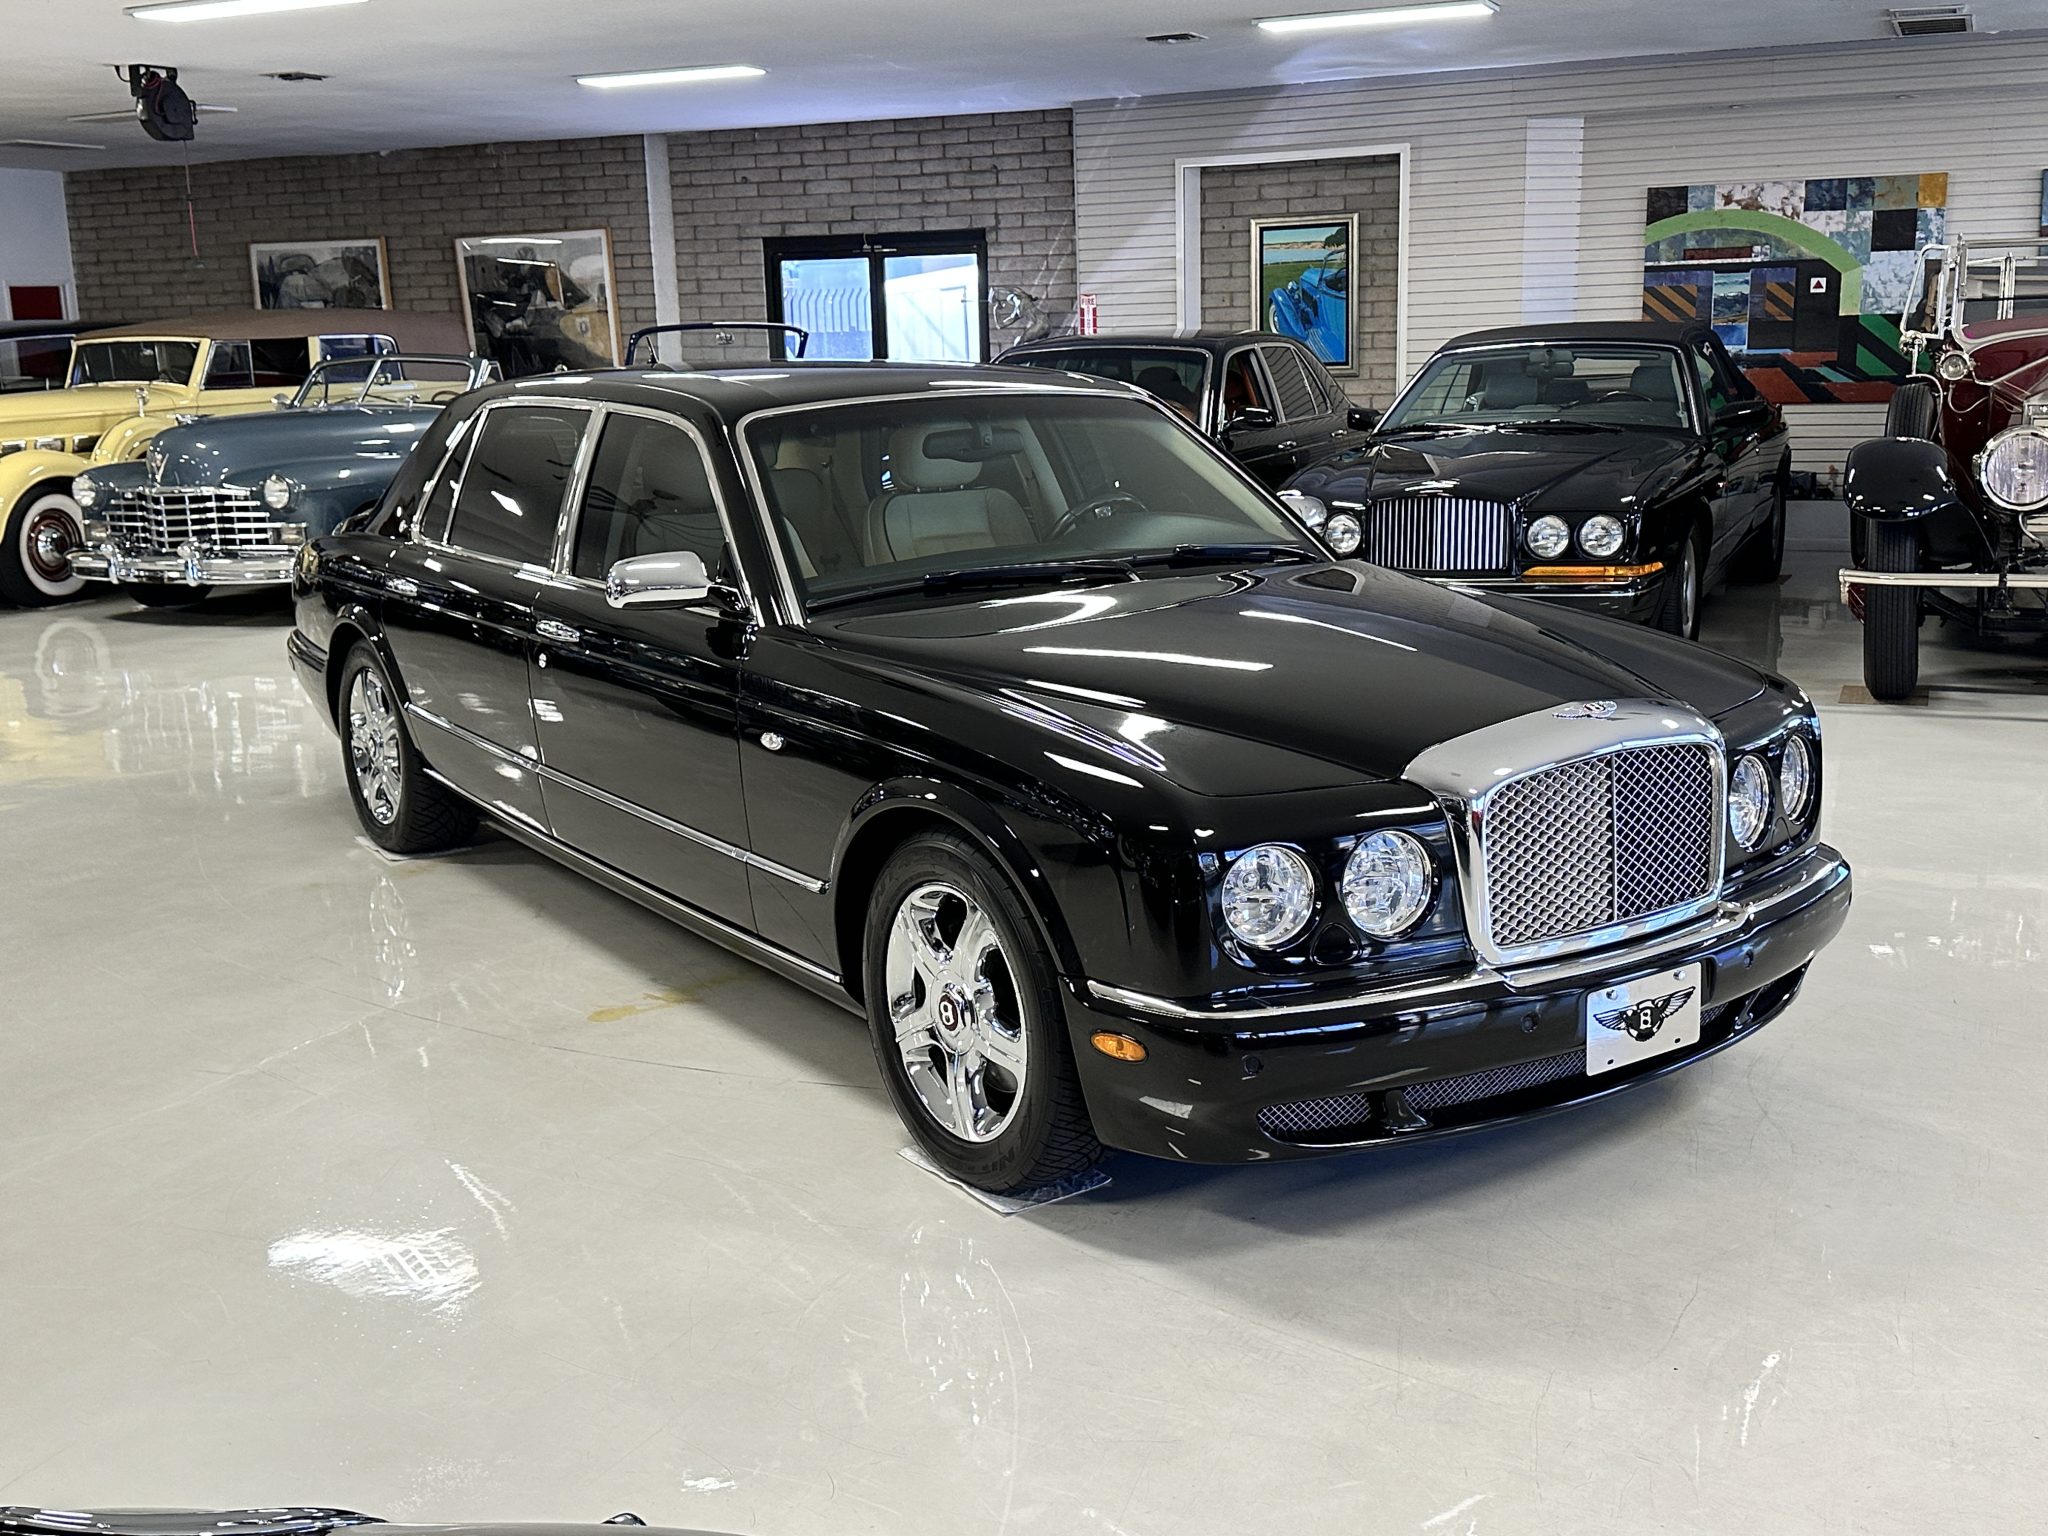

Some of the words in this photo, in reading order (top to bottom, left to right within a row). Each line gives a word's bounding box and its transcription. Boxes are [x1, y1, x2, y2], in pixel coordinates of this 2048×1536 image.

[1081, 297, 1095, 306] FIRE
[939, 1001, 955, 1026] B
[1639, 1008, 1652, 1029] B
